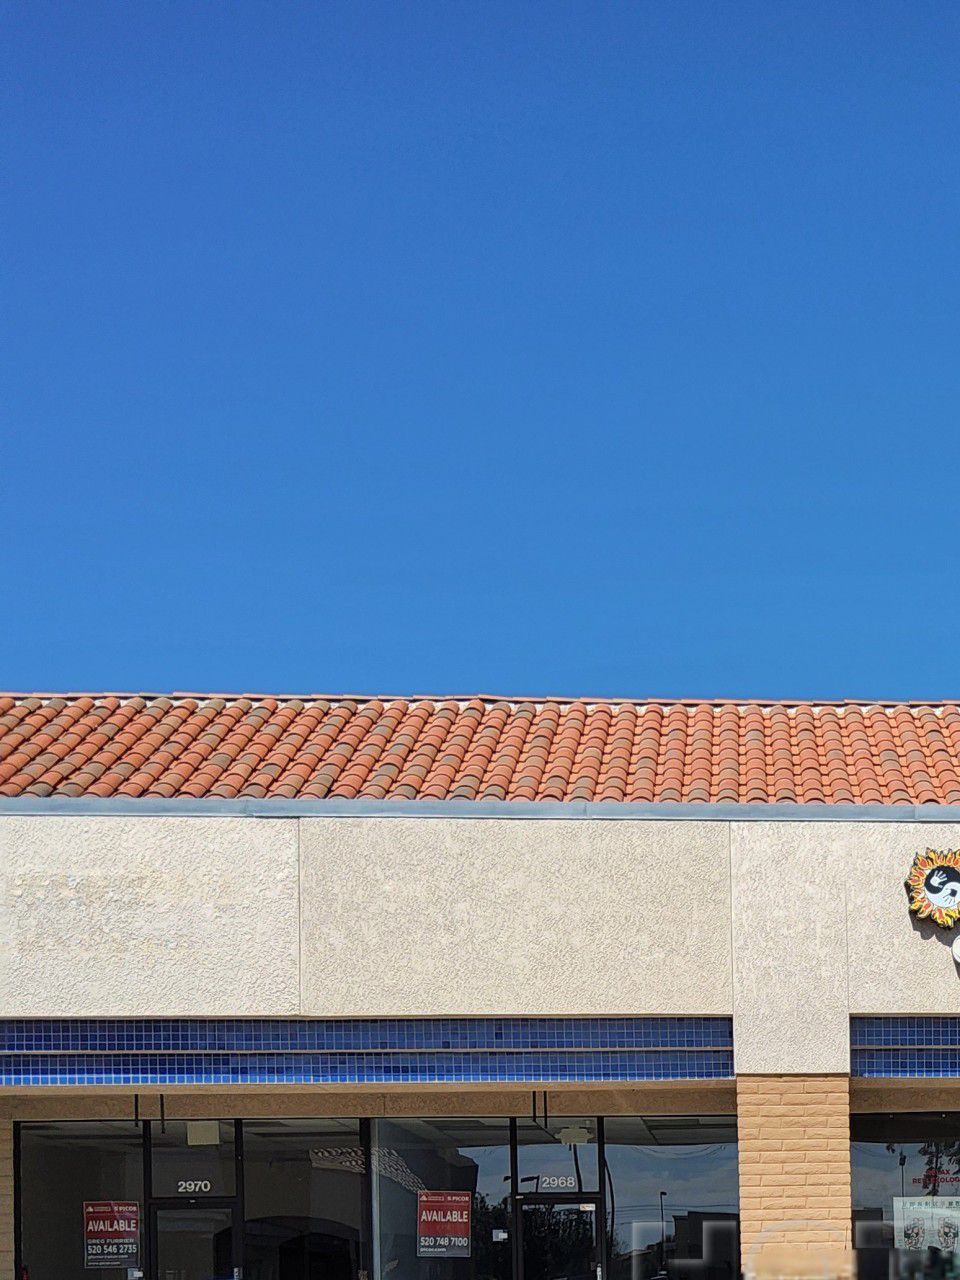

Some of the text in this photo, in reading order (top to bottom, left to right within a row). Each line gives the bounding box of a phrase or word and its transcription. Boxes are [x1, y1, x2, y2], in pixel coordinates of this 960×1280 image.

[177, 1180, 211, 1192] 2970
[541, 1176, 575, 1187] 2968
[421, 1210, 468, 1222] AVAILABLE
[87, 1220, 136, 1232] AVAILABLE
[420, 1237, 468, 1246] 520 748 7100
[87, 1244, 137, 1254] 520 546 2735
